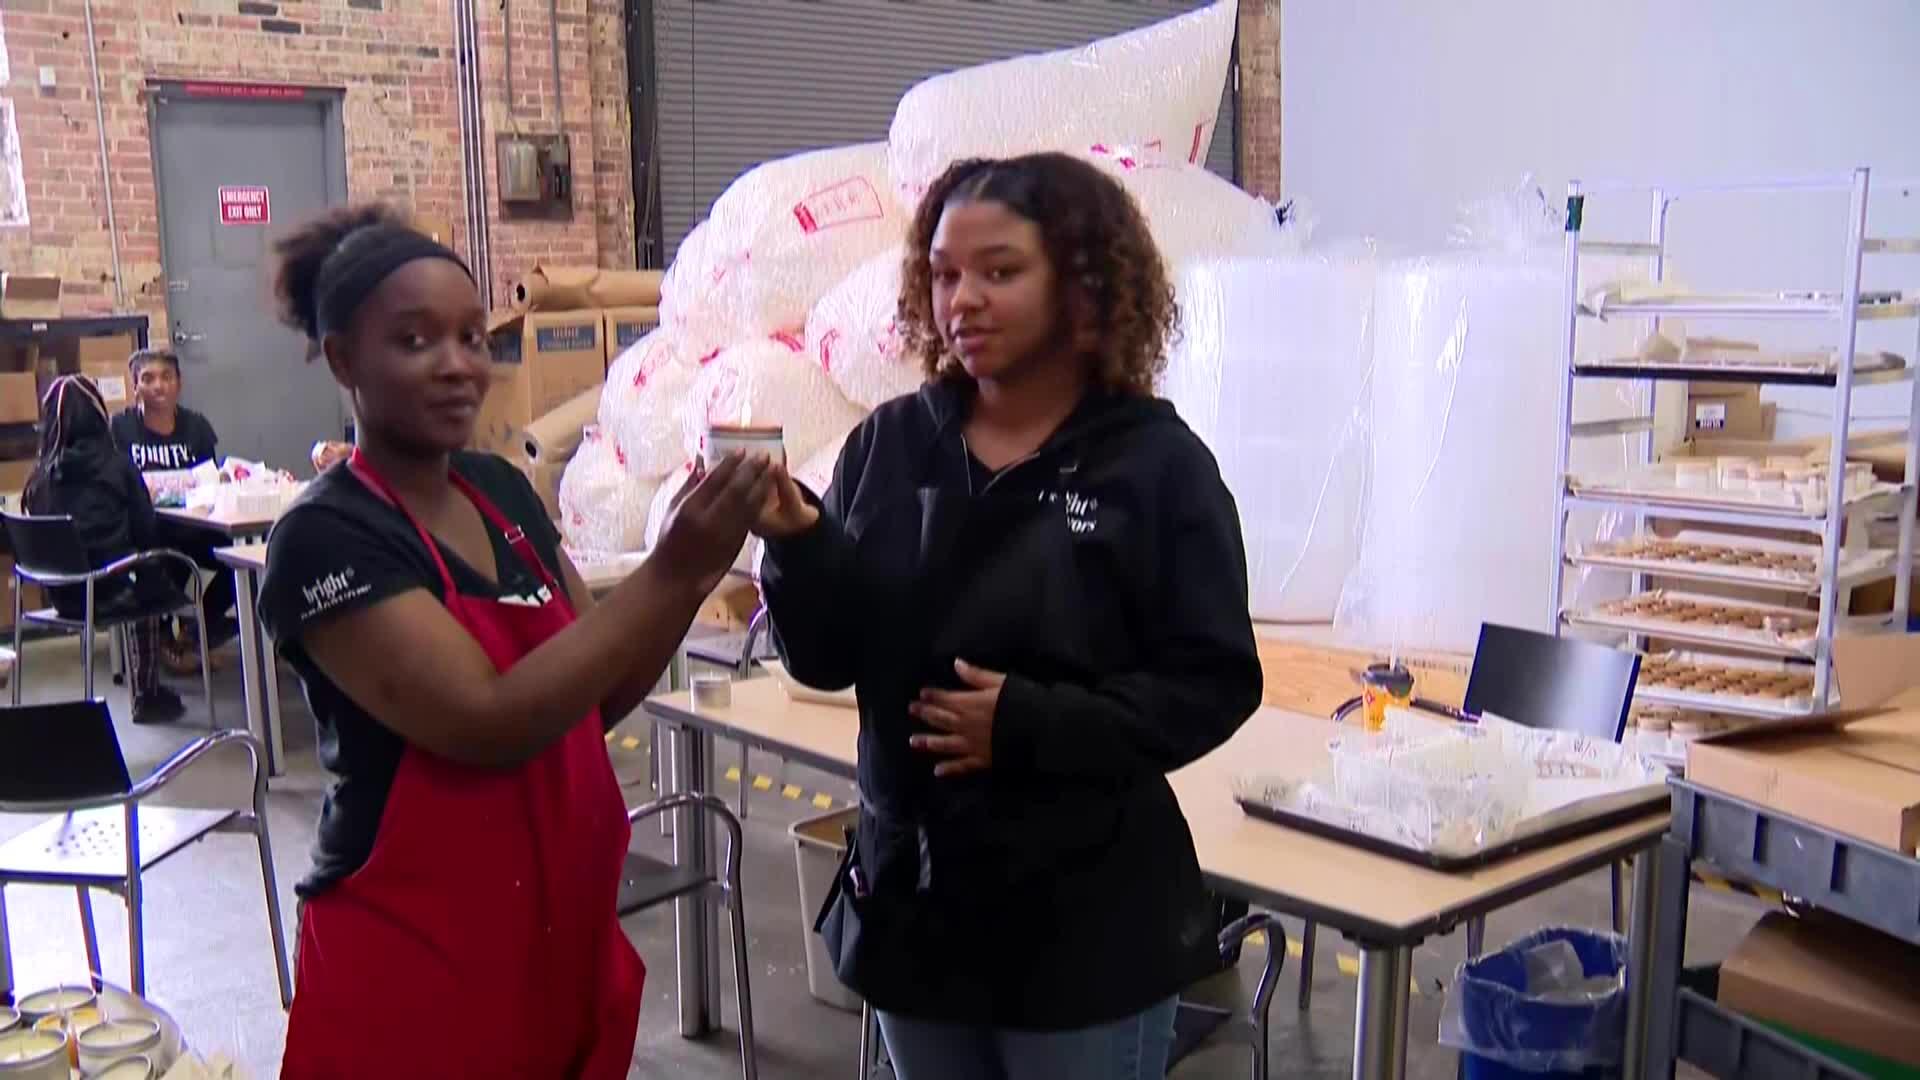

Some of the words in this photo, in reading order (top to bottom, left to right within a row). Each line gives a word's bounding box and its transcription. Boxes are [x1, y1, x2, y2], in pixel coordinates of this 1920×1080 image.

[222, 190, 265, 202] EMERGENCY
[228, 205, 243, 219] EXIT
[244, 205, 262, 219] ONLY
[302, 571, 349, 611] bright
